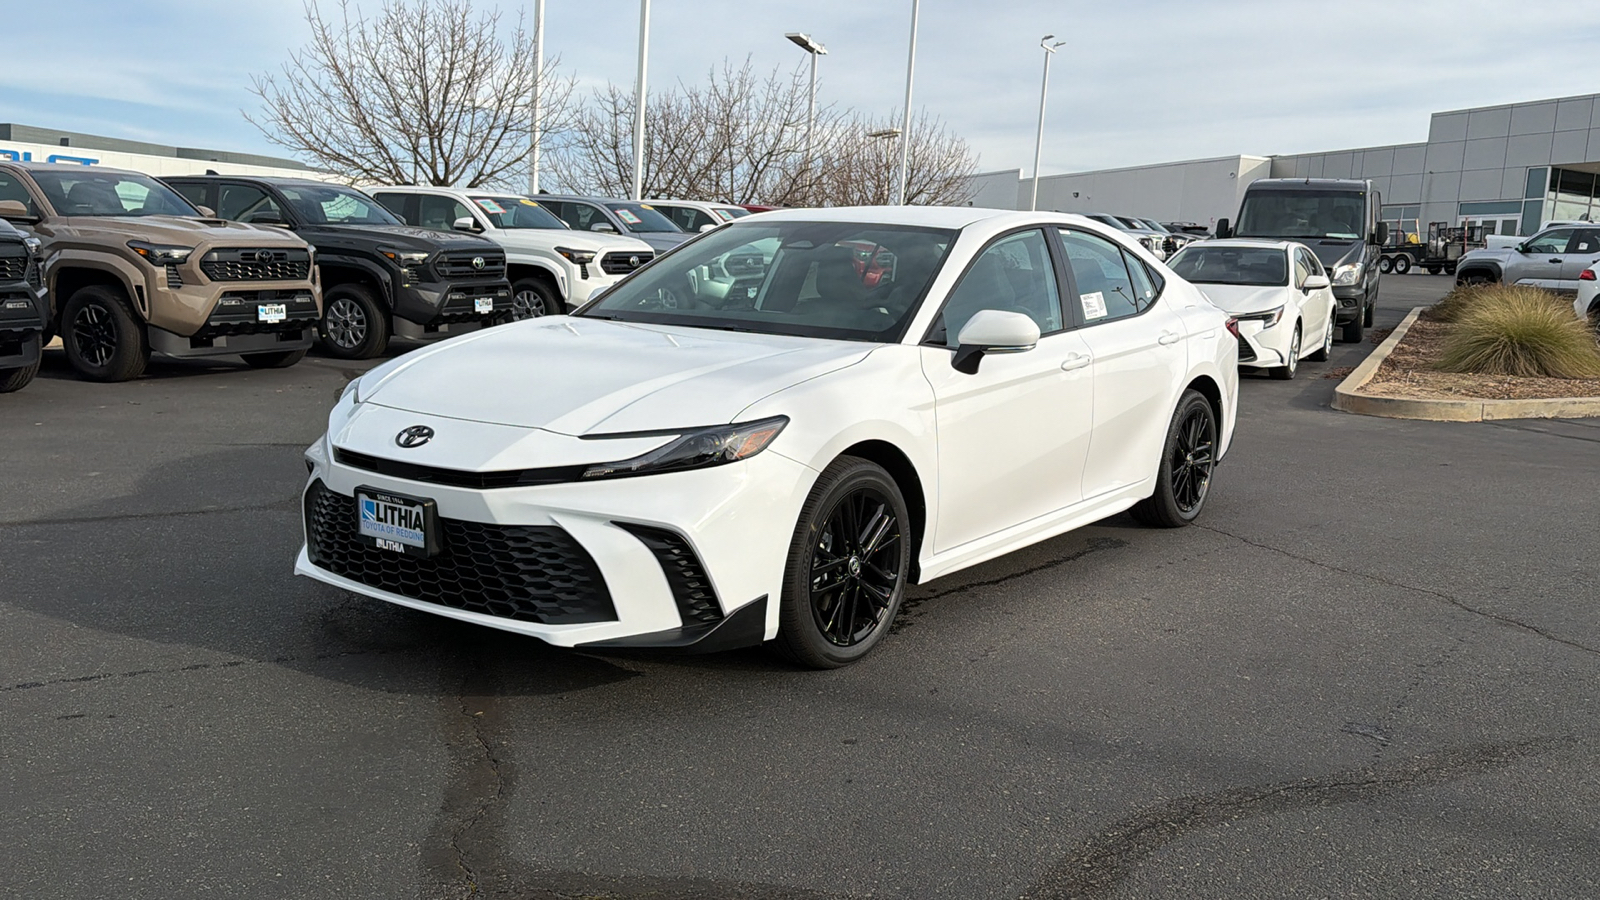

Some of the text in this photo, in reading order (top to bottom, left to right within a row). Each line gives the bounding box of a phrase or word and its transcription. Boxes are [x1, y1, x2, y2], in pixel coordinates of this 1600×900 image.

[264, 307, 284, 315] LITHIA
[375, 502, 424, 532] LITHIA
[362, 520, 386, 533] TOYOTA
[386, 525, 395, 535] OF
[383, 539, 405, 554] LITHIA
